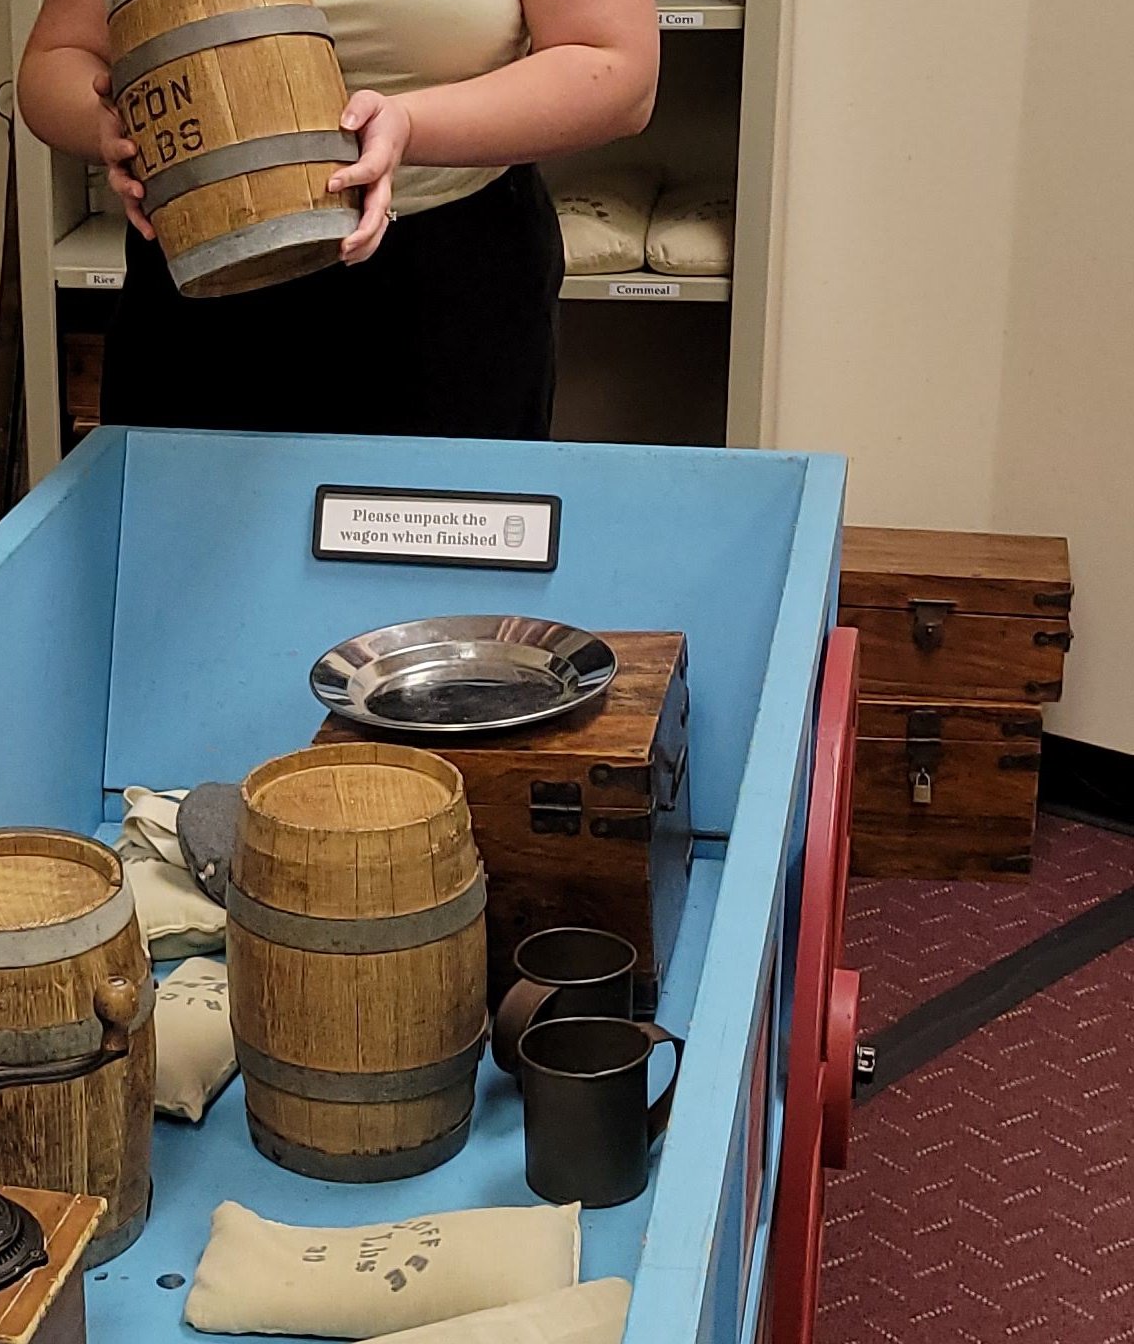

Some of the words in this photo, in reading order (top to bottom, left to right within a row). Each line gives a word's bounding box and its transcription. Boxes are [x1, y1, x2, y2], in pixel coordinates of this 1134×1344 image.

[666, 14, 694, 24] Corn
[120, 75, 193, 133] CON
[138, 118, 204, 174] LBS
[93, 275, 116, 285] Rice
[616, 285, 670, 296] Cornmeal
[352, 509, 401, 523] Please
[403, 512, 459, 527] unpack
[462, 513, 487, 526] the
[340, 529, 389, 545] wagon
[392, 530, 432, 544] when
[436, 532, 497, 546] finished
